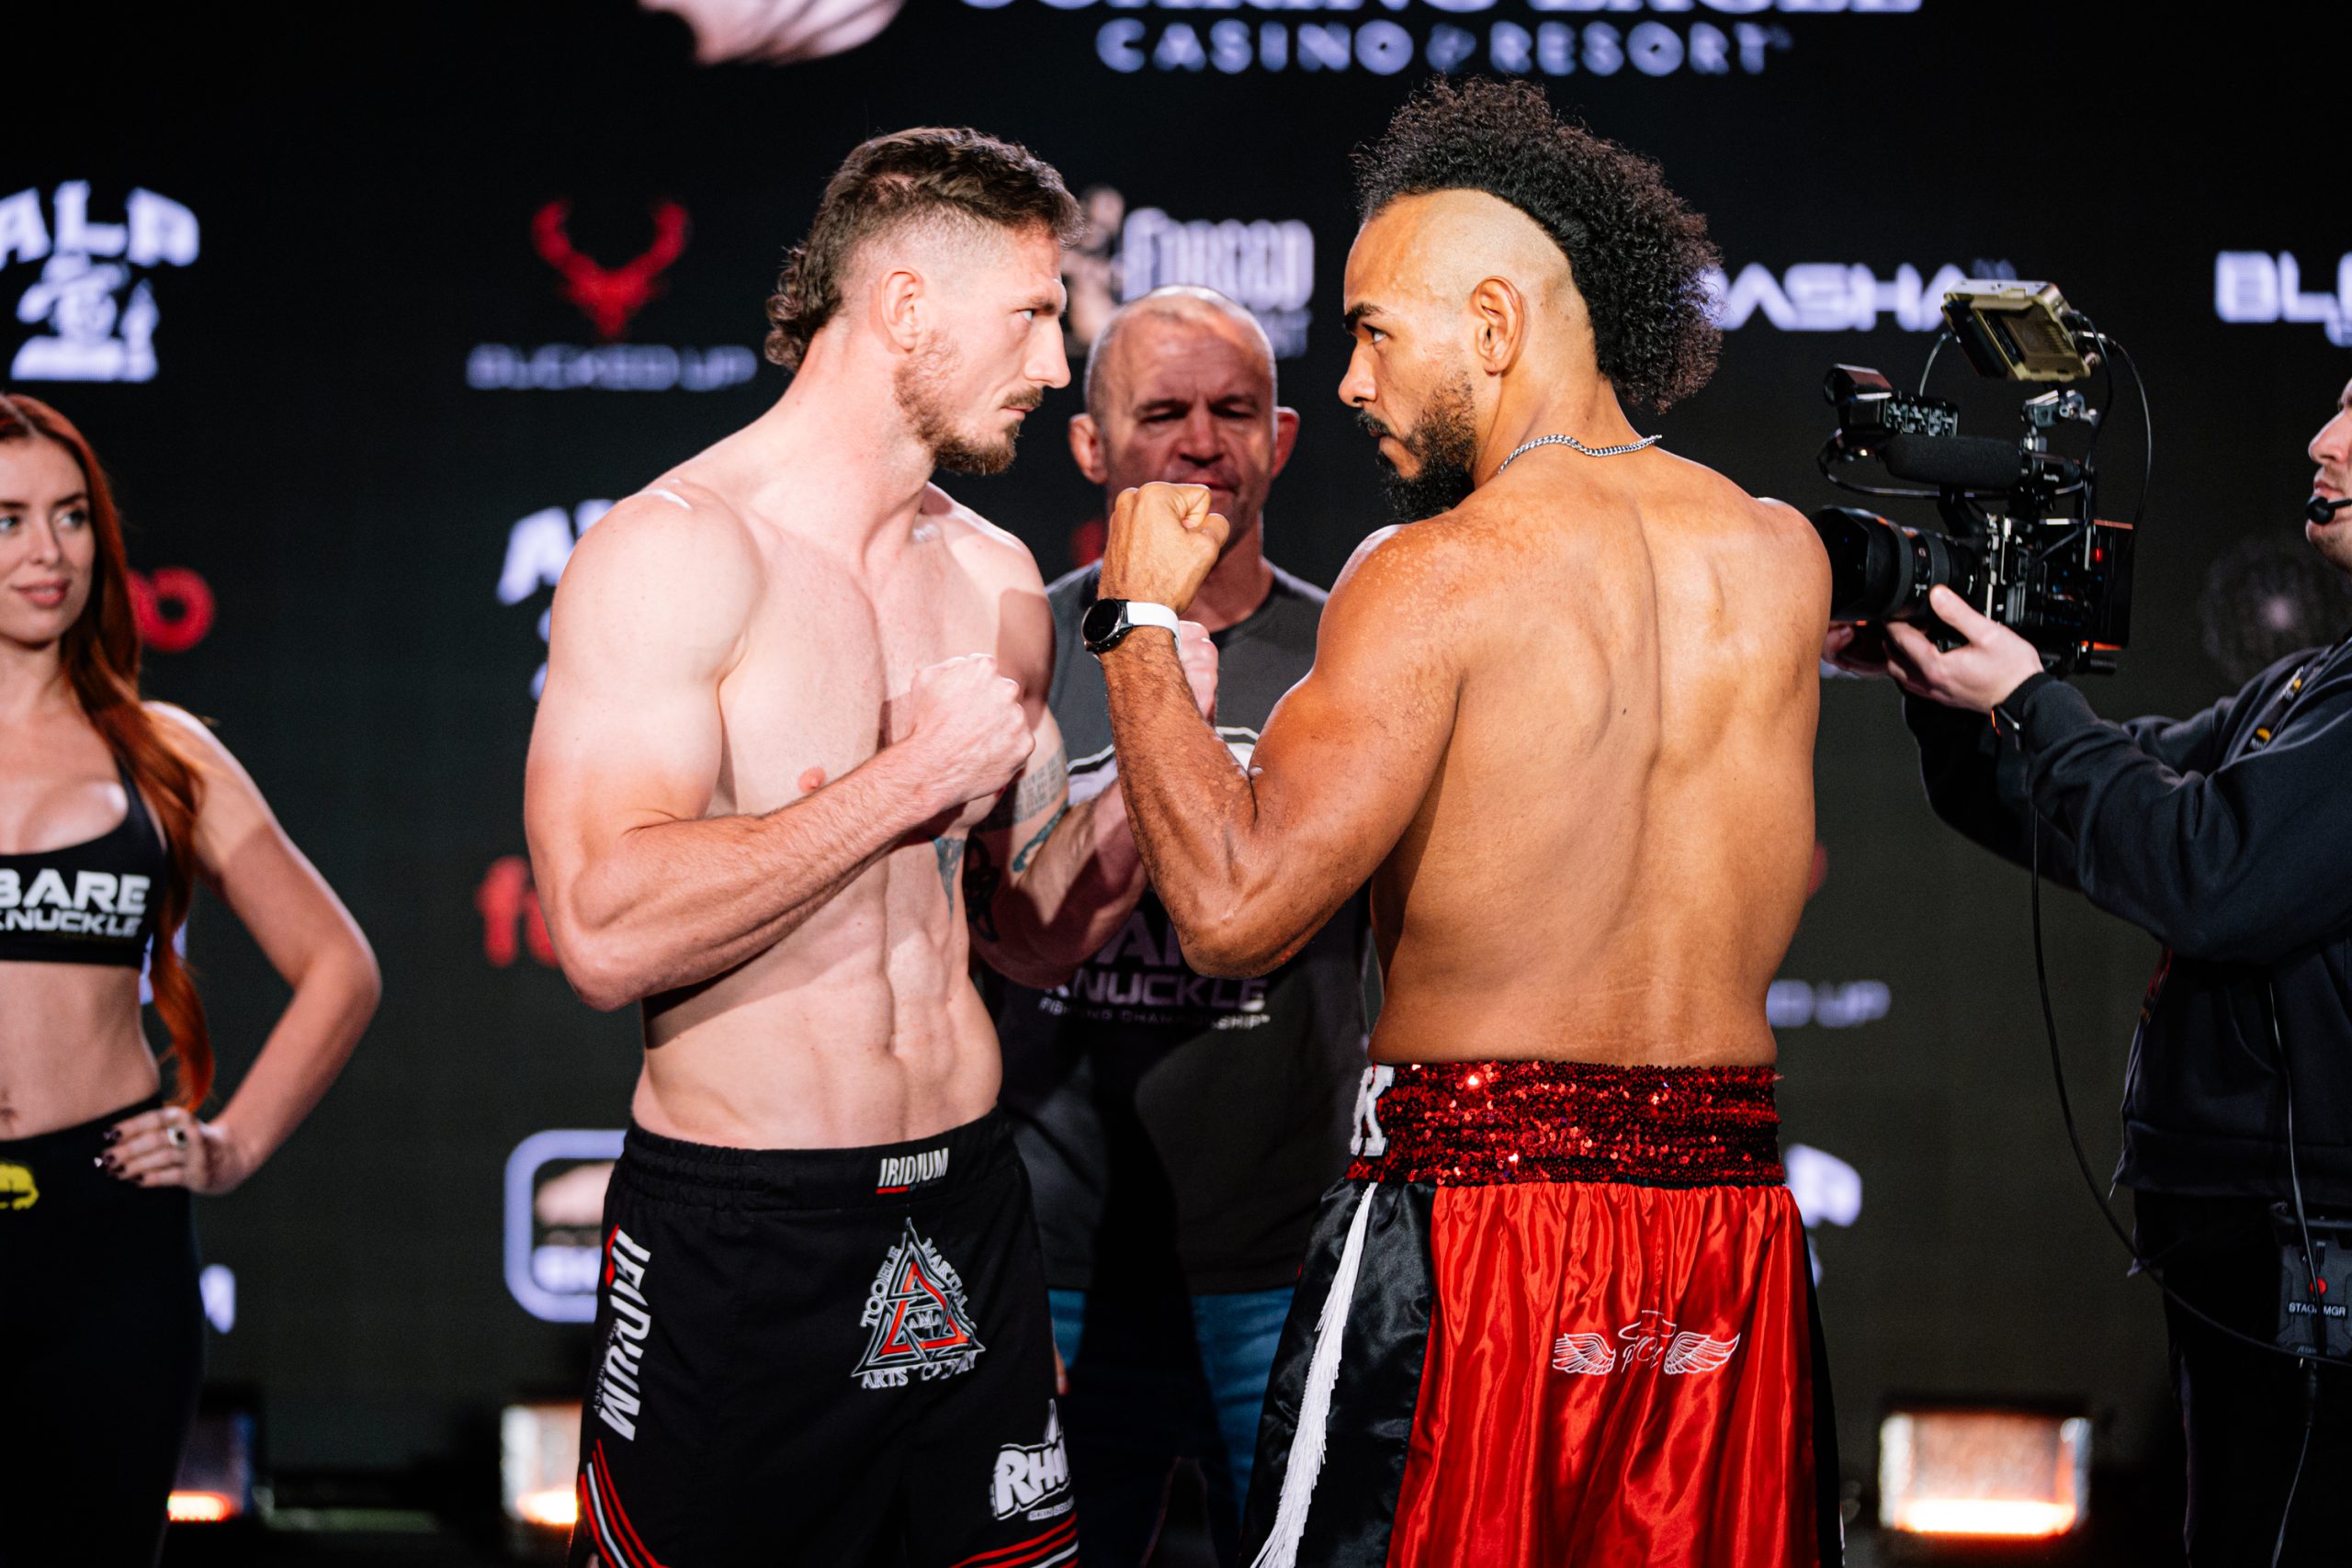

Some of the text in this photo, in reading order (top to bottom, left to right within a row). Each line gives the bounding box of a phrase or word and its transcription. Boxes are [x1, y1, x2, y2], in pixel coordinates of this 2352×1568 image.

[1096, 18, 1413, 74] CASINO
[1489, 21, 1766, 75] RESORT
[0, 908, 142, 937] NUCKLE
[877, 1147, 949, 1188] IRIDIUM
[2289, 1303, 2346, 1317] STAG MGR
[861, 1368, 909, 1389] ARTS
